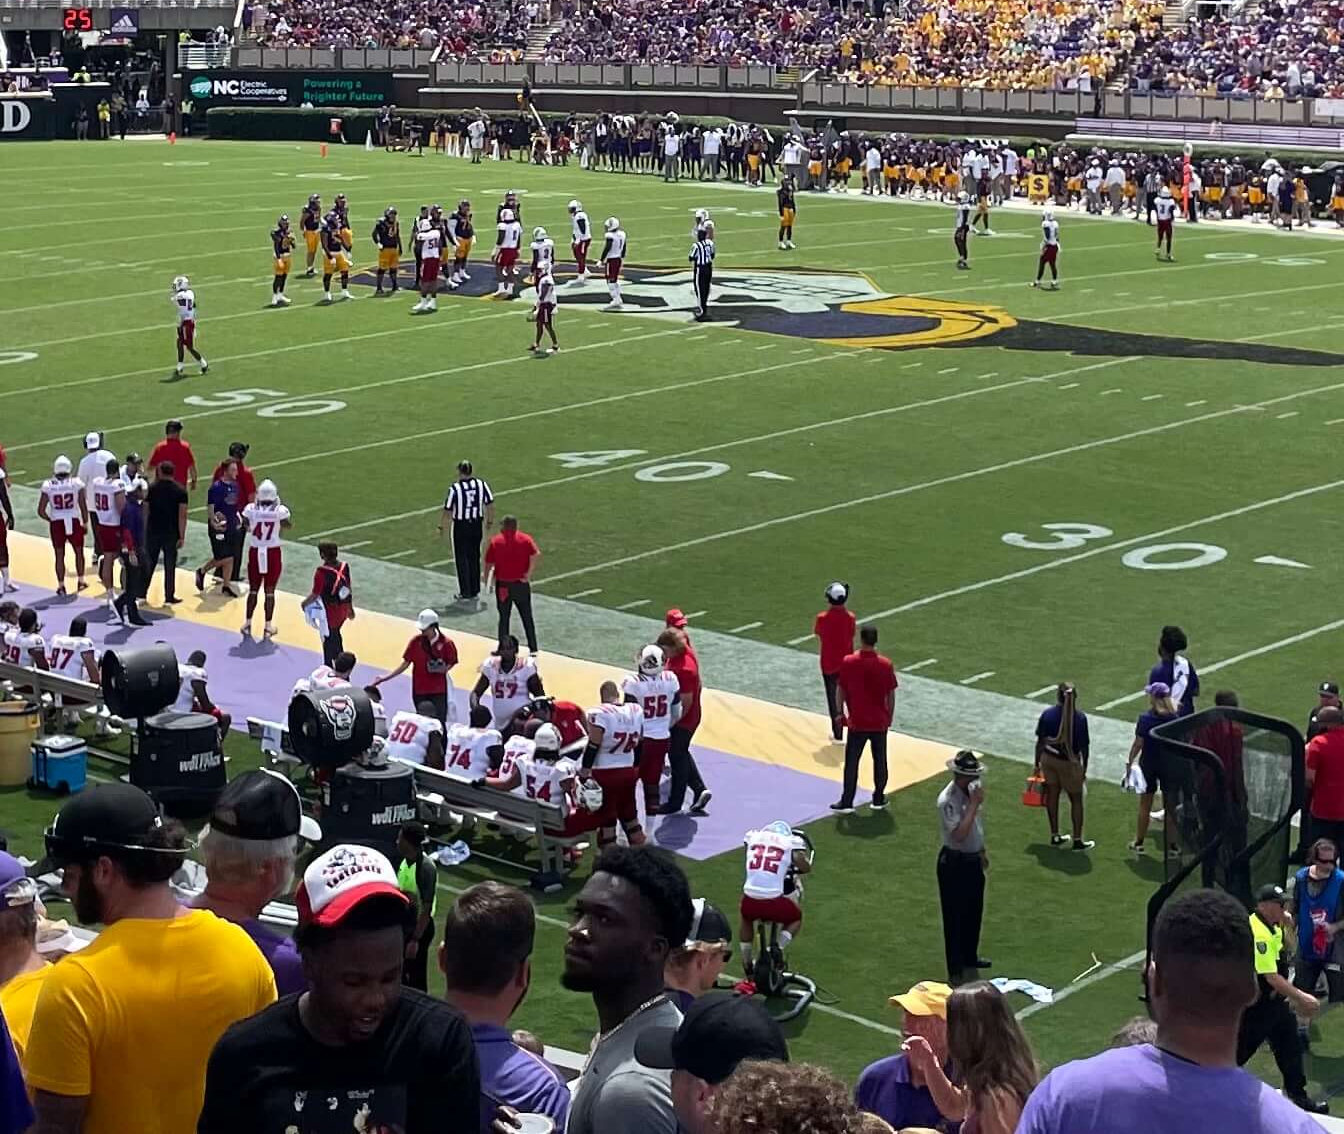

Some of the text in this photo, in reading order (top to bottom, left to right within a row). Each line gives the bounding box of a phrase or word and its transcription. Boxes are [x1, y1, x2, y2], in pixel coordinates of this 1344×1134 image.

[65, 9, 92, 29] 25
[213, 80, 240, 96] NC
[349, 92, 385, 103] Future
[252, 522, 275, 541] 47
[1001, 523, 1227, 570] 30
[643, 695, 669, 718] 56
[390, 719, 419, 743] 50
[448, 745, 472, 770] 74
[526, 779, 552, 802] 54
[749, 843, 785, 875] 32
